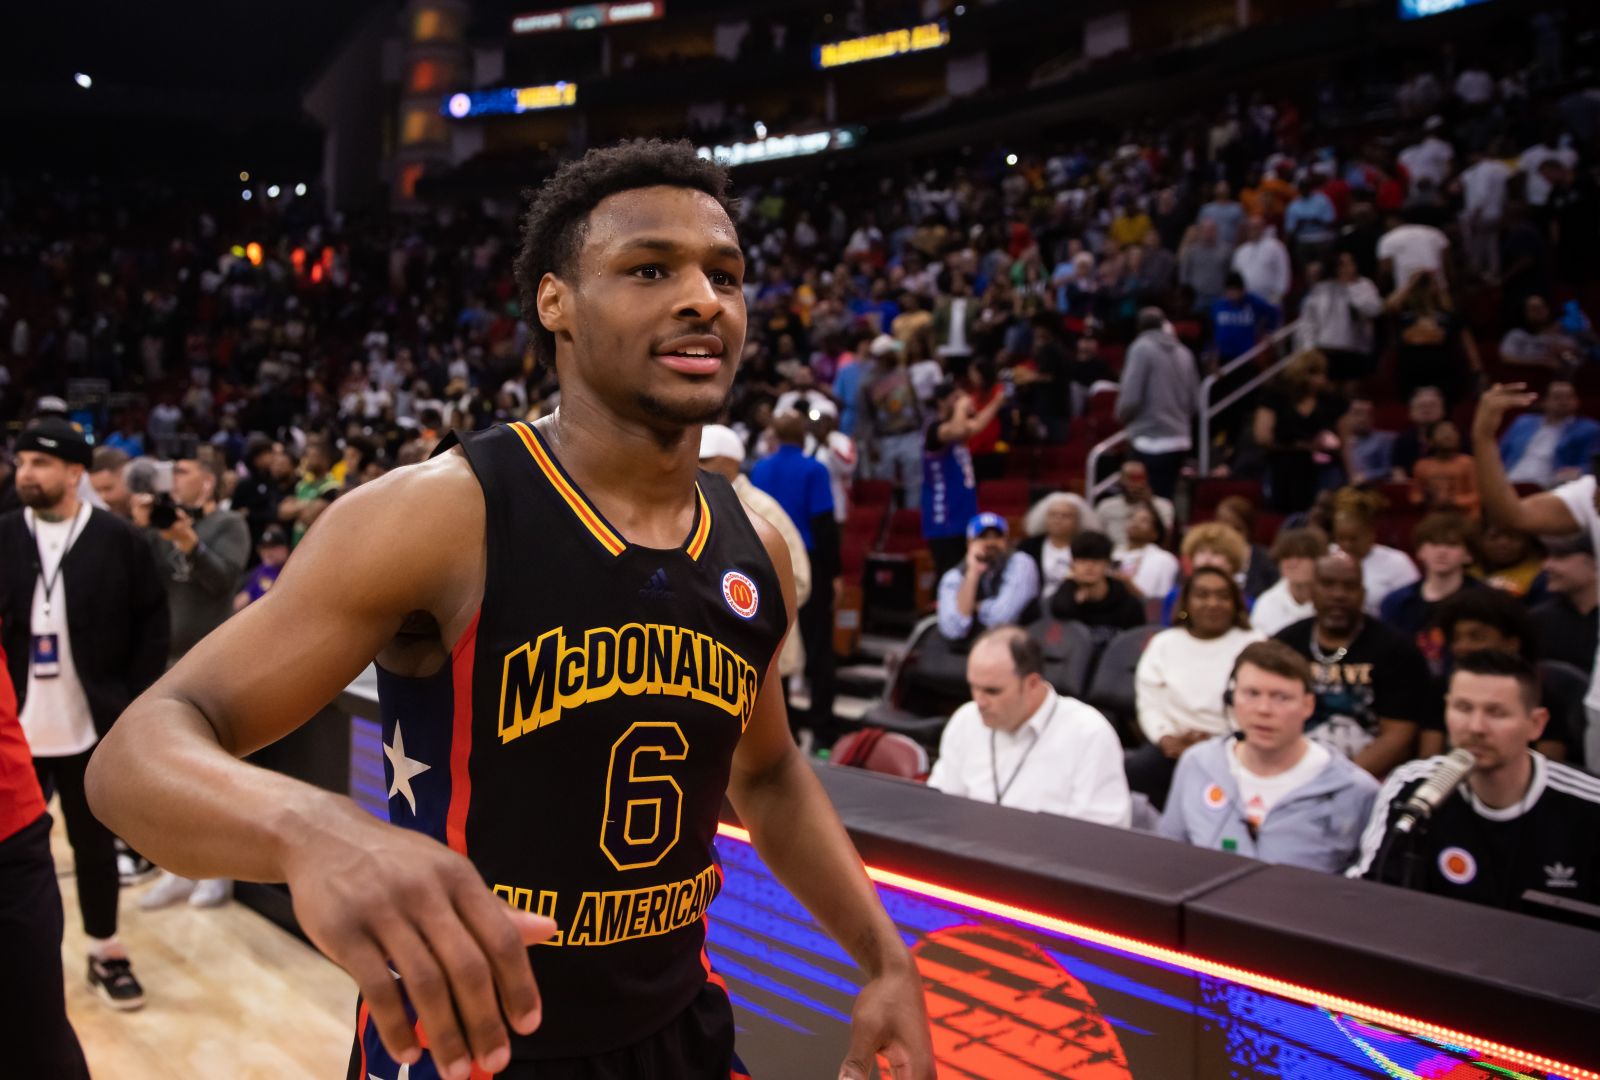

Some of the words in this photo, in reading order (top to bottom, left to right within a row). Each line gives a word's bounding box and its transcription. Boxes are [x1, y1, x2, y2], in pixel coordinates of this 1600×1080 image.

[498, 622, 758, 744] McDONALD'S
[600, 721, 689, 872] 6
[567, 864, 715, 946] AMERICAN
